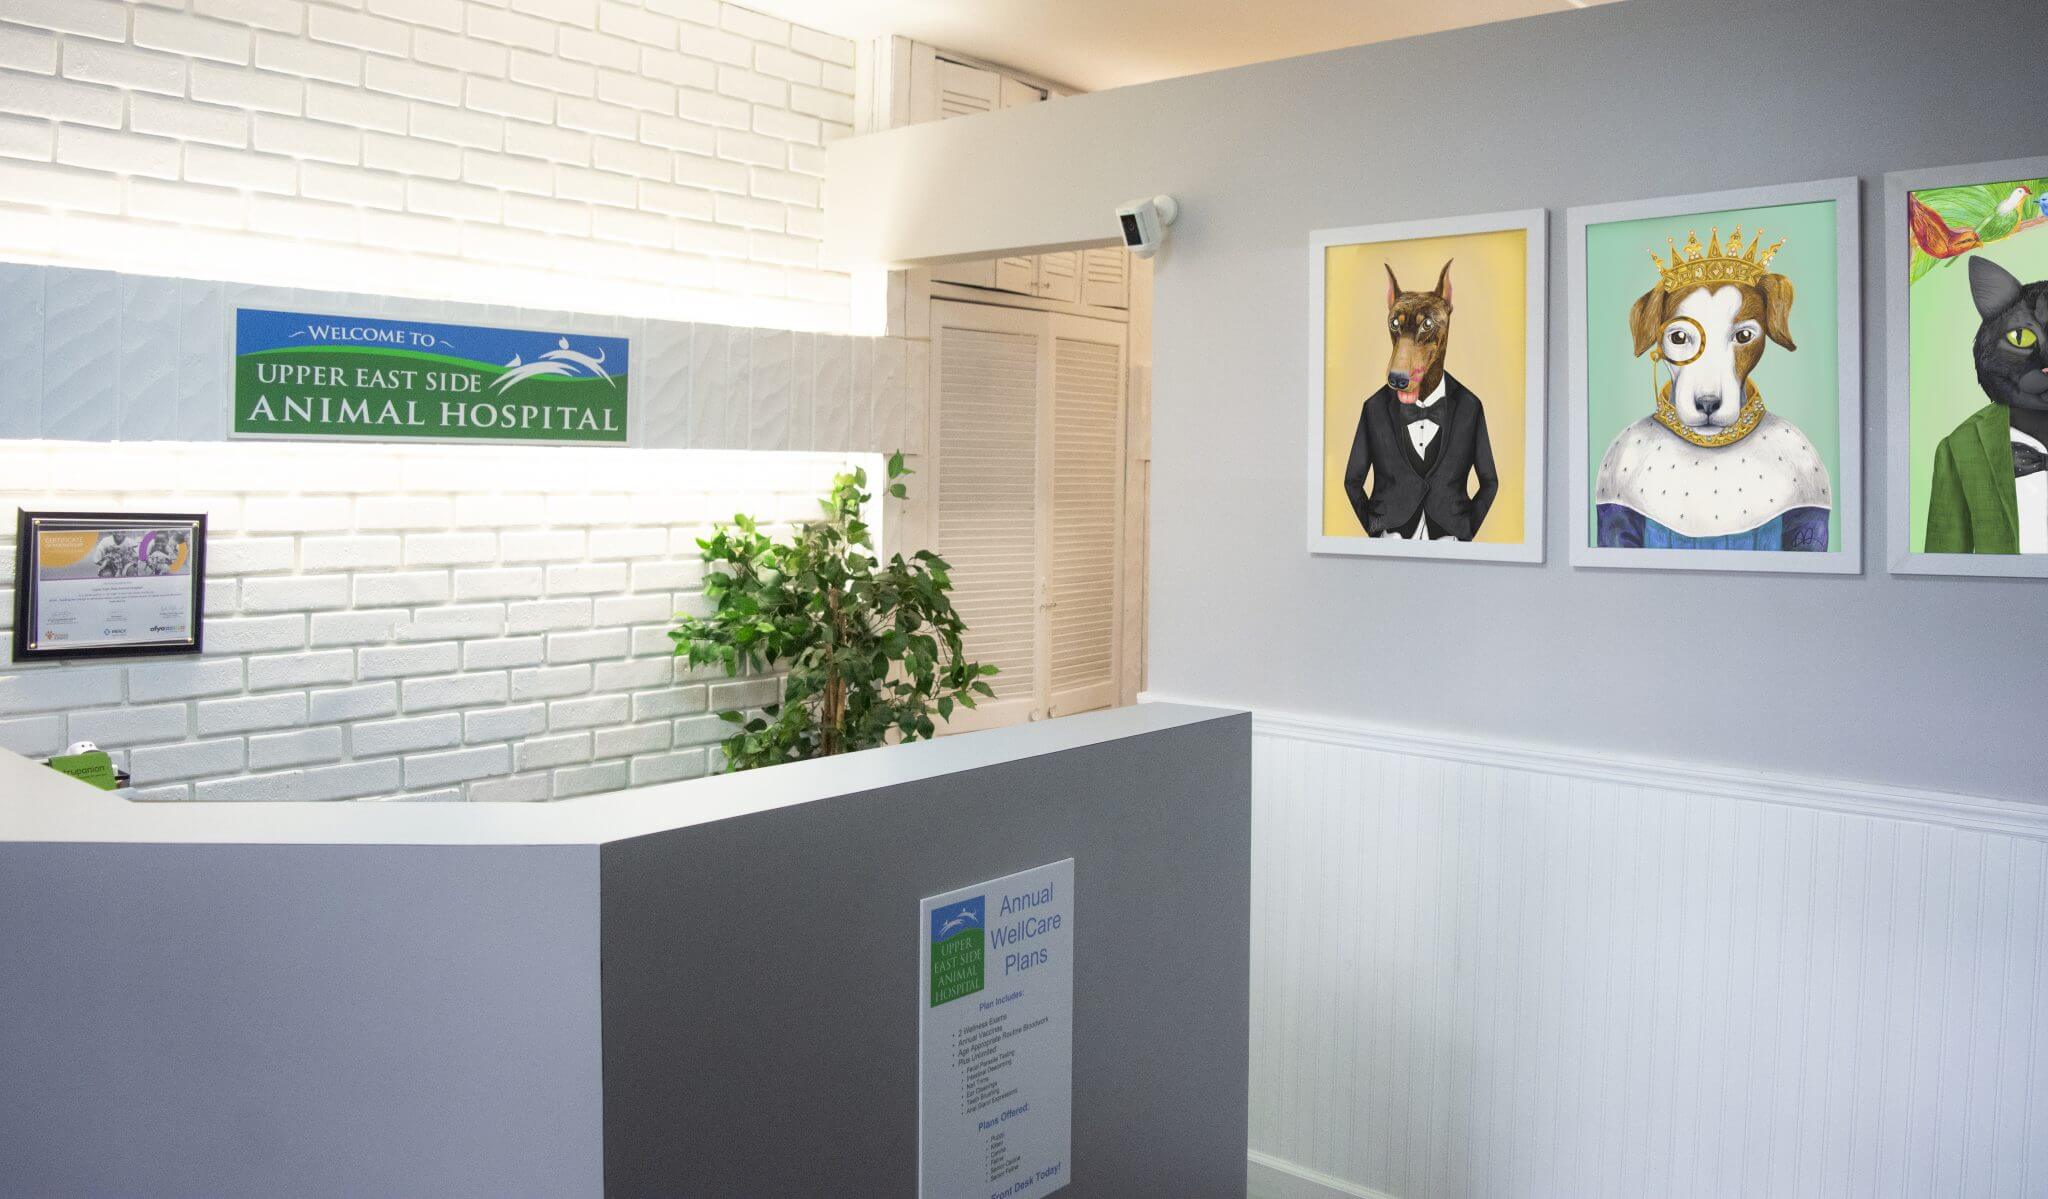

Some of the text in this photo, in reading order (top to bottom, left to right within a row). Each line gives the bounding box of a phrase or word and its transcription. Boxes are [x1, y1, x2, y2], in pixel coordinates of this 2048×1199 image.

[307, 325, 435, 348] WELCOME TO
[257, 363, 482, 393] UPPER EAST SIDE
[247, 394, 619, 431] ANIMAL HOSPITAL
[1000, 882, 1053, 916] Annual
[991, 914, 1062, 949] WellCare
[941, 937, 973, 956] UPPER
[934, 948, 982, 974] EAST SIDE
[1005, 948, 1048, 976] Plans
[938, 965, 978, 987] ANIMAL
[936, 978, 979, 1002] HOSPITAL
[979, 999, 994, 1012] Plan
[979, 1118, 999, 1133] Plans
[1015, 1177, 1033, 1193] Desk
[1036, 1162, 1061, 1182] Today!
